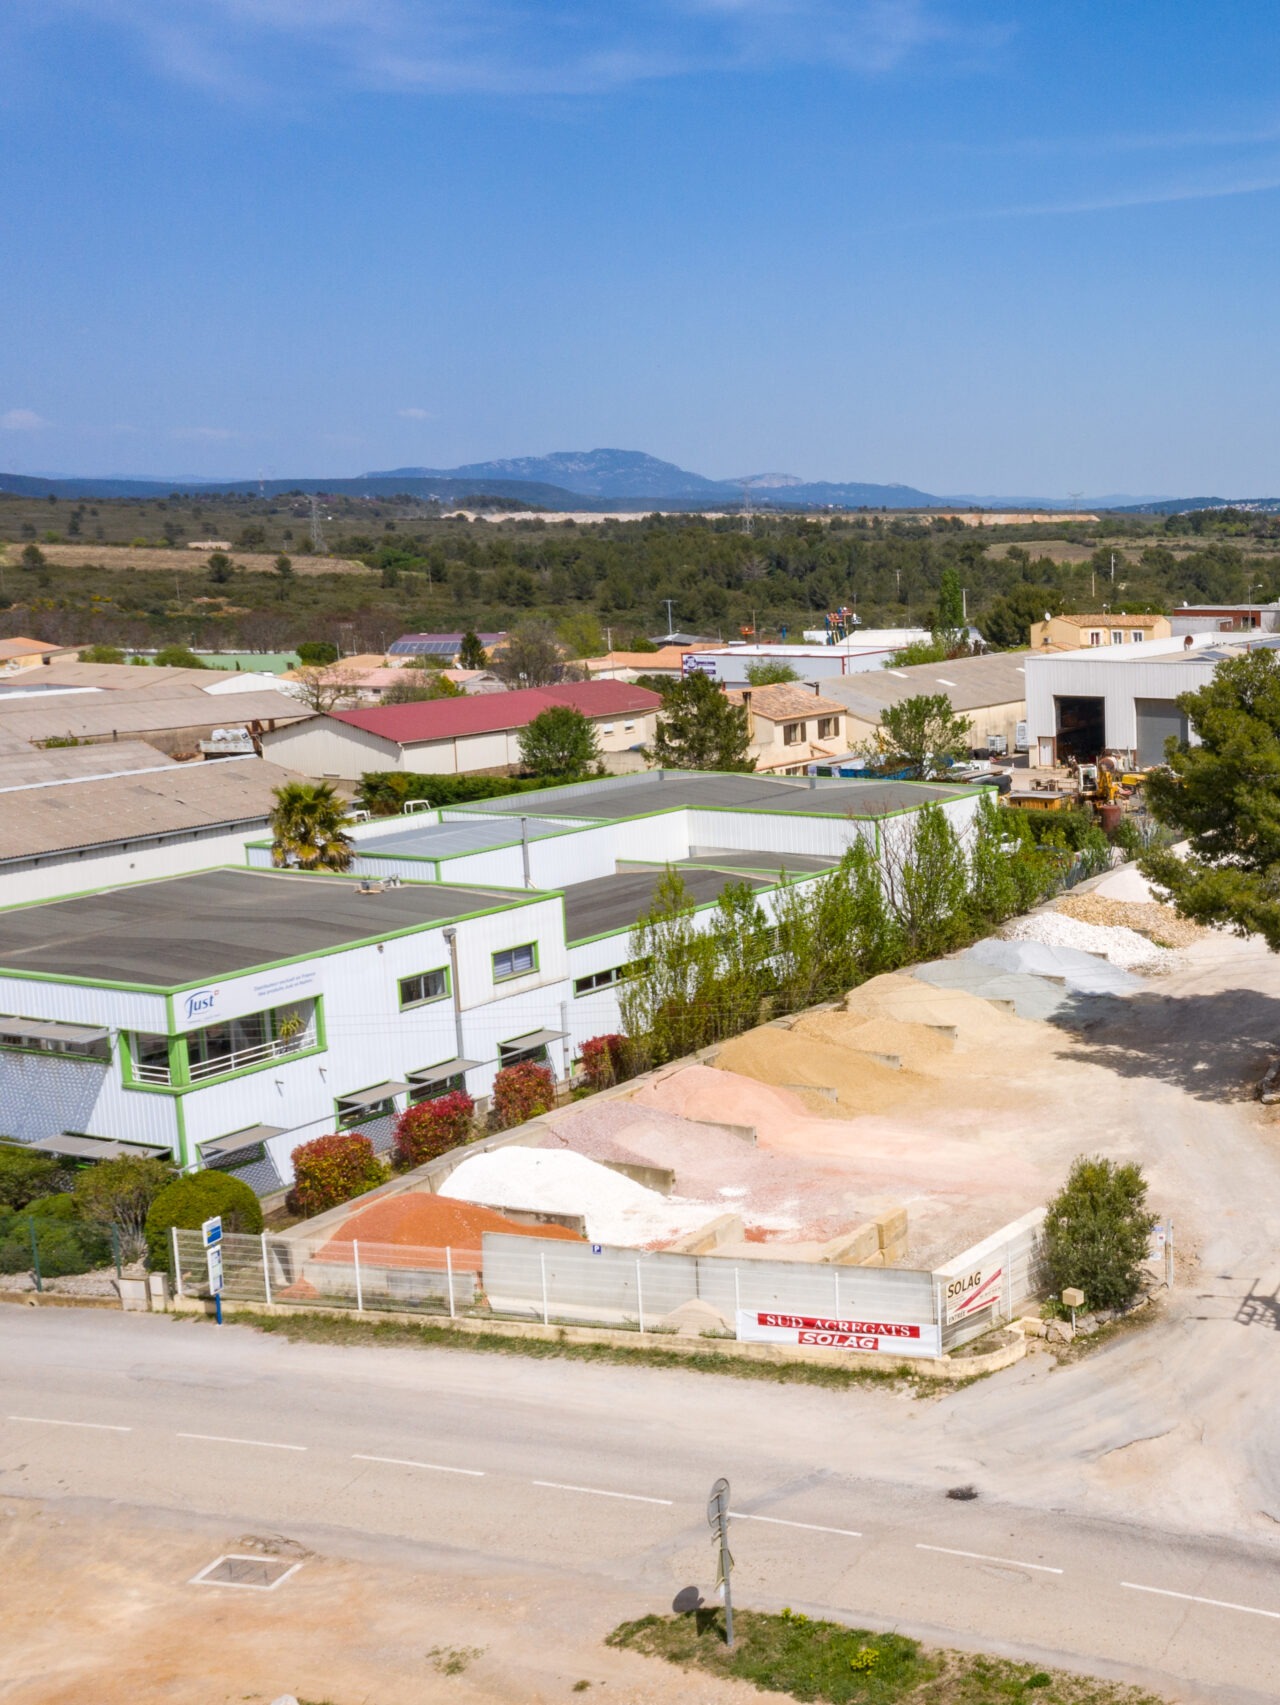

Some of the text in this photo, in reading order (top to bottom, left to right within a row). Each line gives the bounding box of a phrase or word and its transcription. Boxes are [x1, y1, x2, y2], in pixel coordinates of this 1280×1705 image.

[186, 994, 215, 1019] Just
[947, 1271, 982, 1299] SOLAG
[766, 1314, 911, 1337] SUD AGREGATS
[801, 1332, 875, 1349] SOLAG
